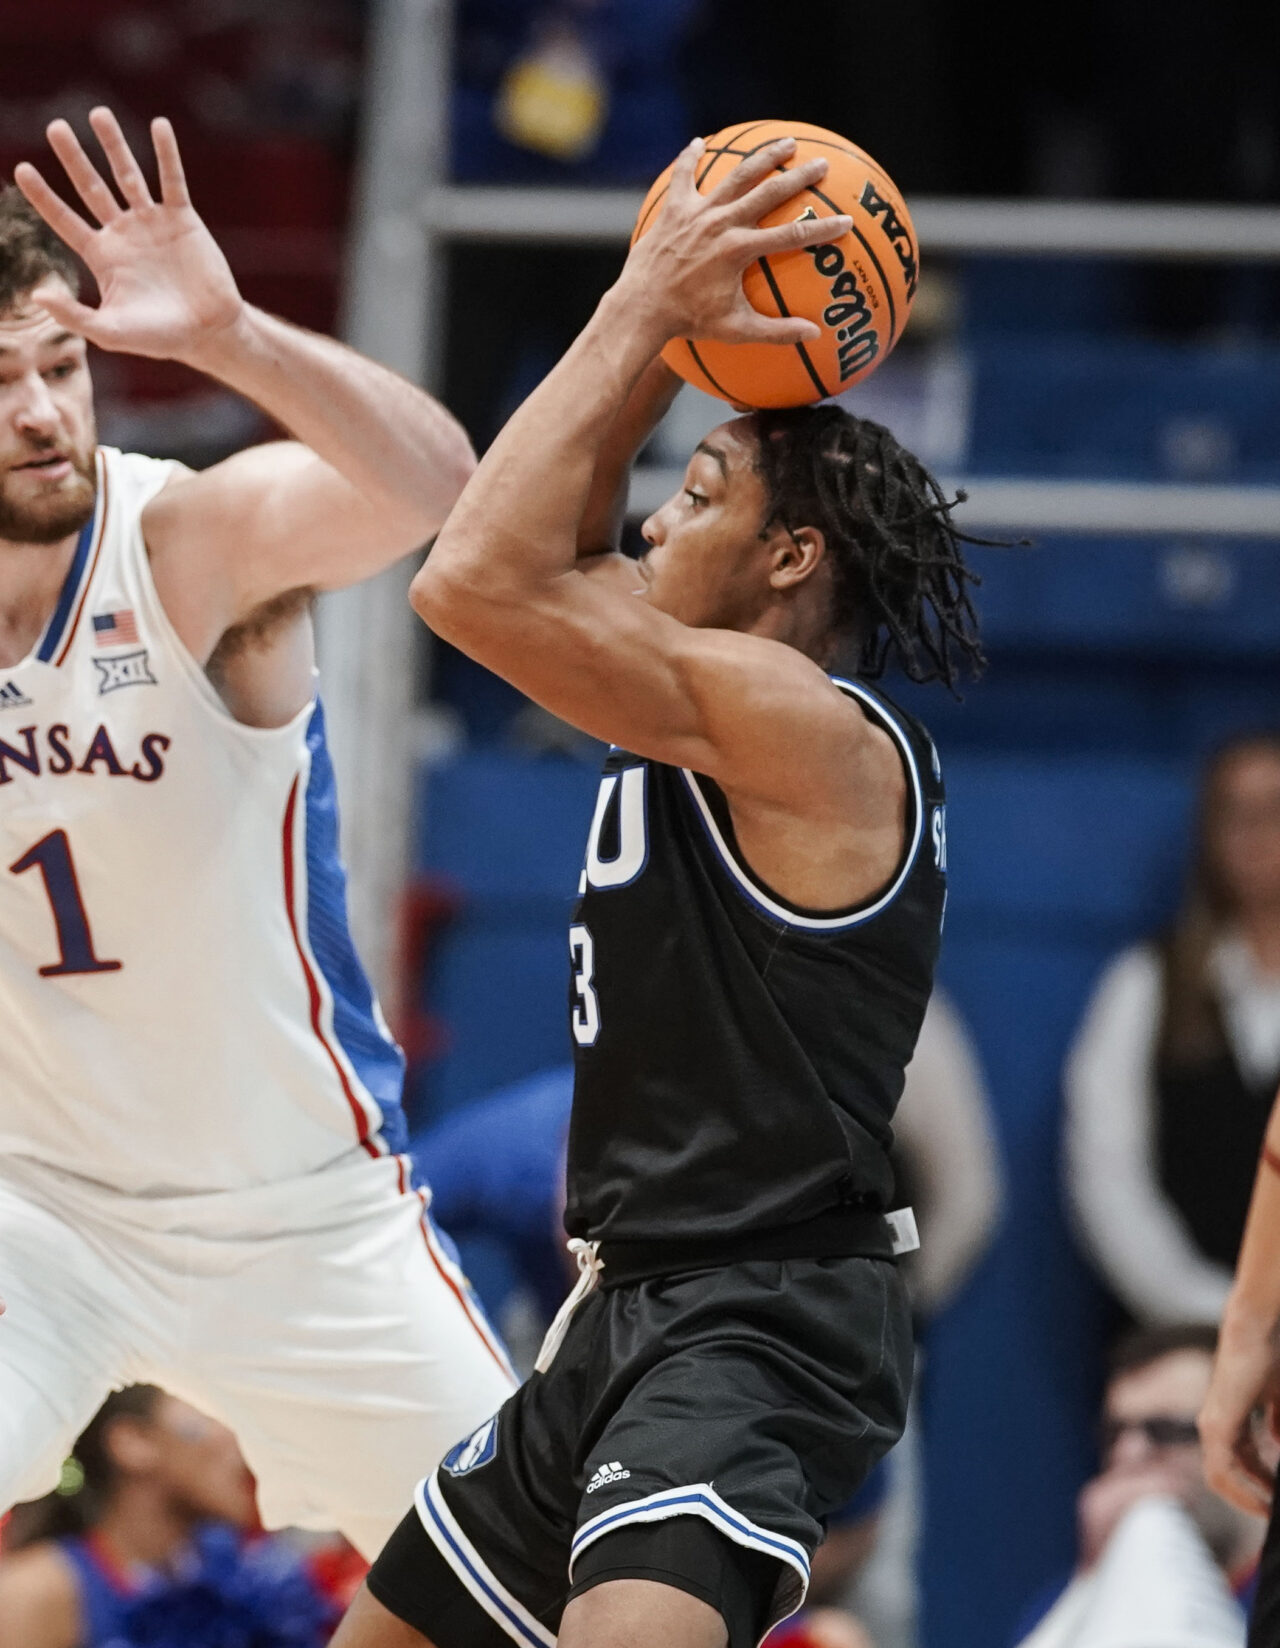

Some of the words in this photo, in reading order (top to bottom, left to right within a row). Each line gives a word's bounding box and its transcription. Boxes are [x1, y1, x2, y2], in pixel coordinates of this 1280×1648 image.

[8, 828, 125, 978] 1
[568, 922, 602, 1047] 3
[586, 1470, 631, 1494] adidas
